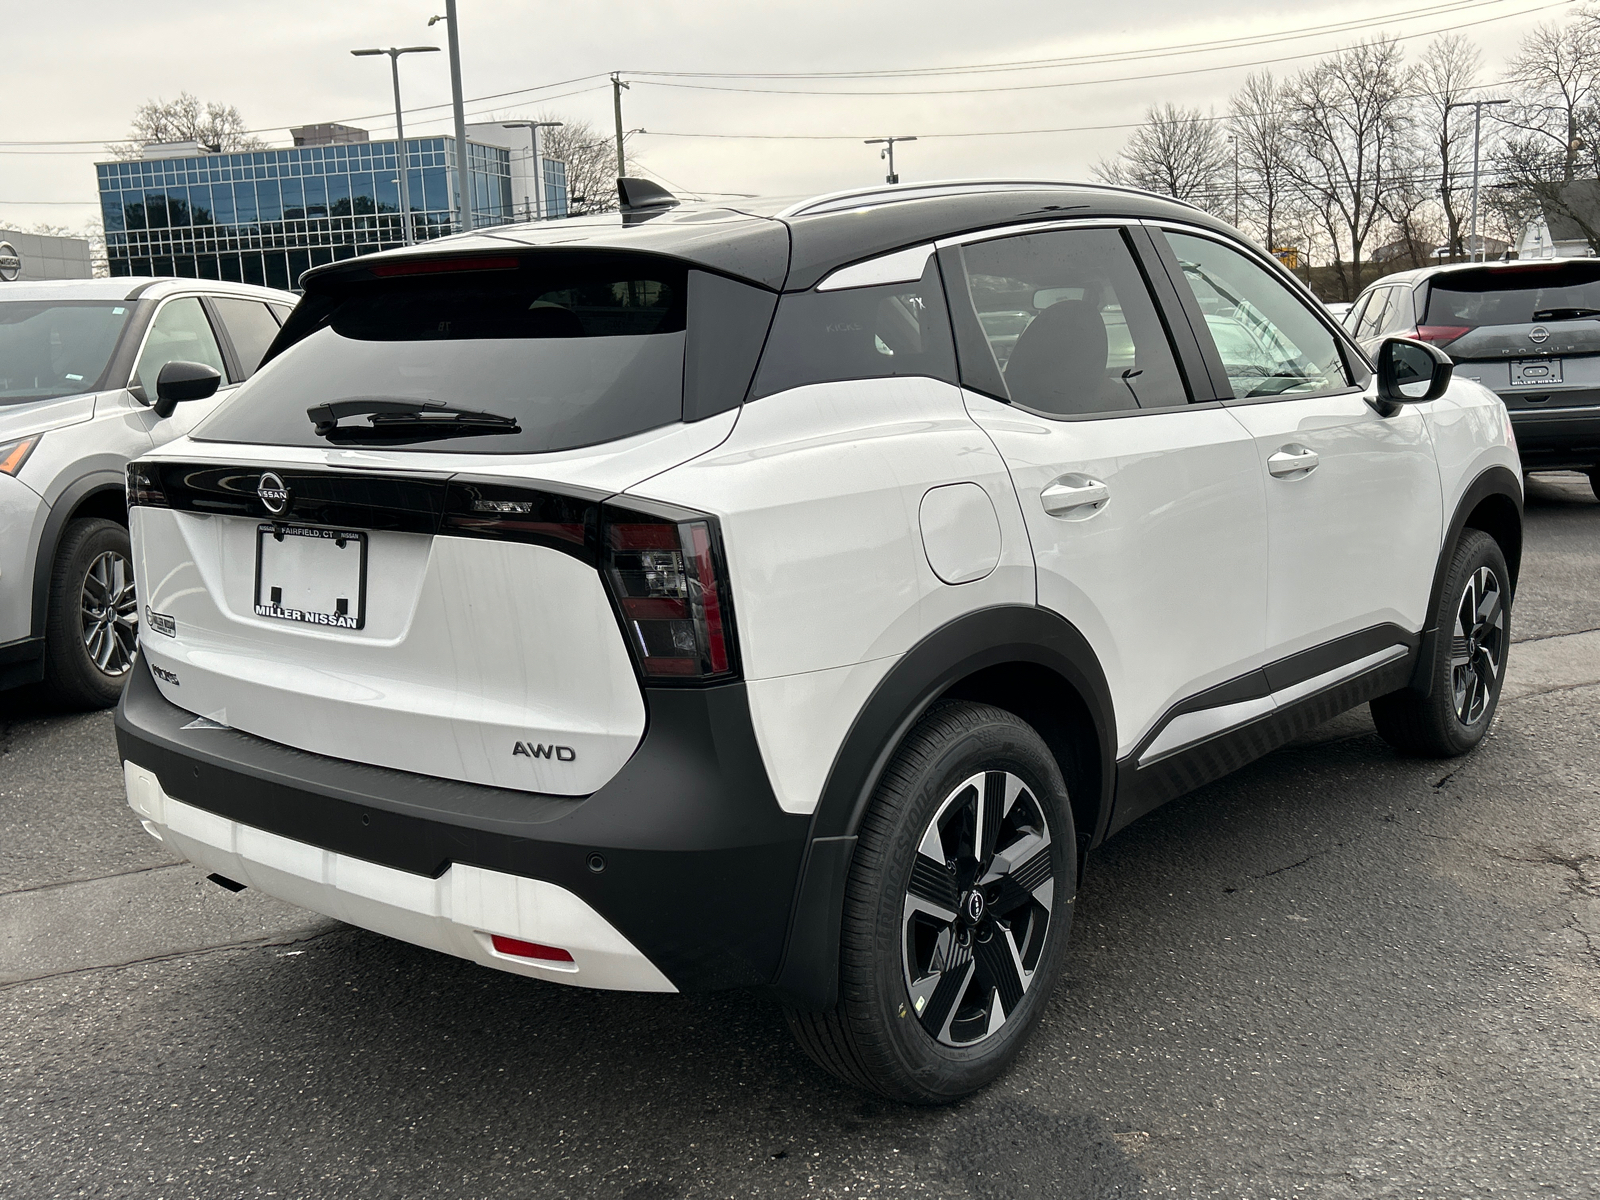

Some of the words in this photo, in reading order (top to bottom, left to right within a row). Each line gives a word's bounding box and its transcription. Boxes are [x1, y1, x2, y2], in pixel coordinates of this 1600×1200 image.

[826, 322, 862, 333] KICKS
[281, 527, 321, 538] FAIRFIELD,
[323, 530, 334, 538] CT
[255, 604, 301, 621] MILLER
[304, 612, 357, 629] NISSAN
[512, 740, 577, 762] AWD
[876, 778, 934, 950] BRIDGESTONE
